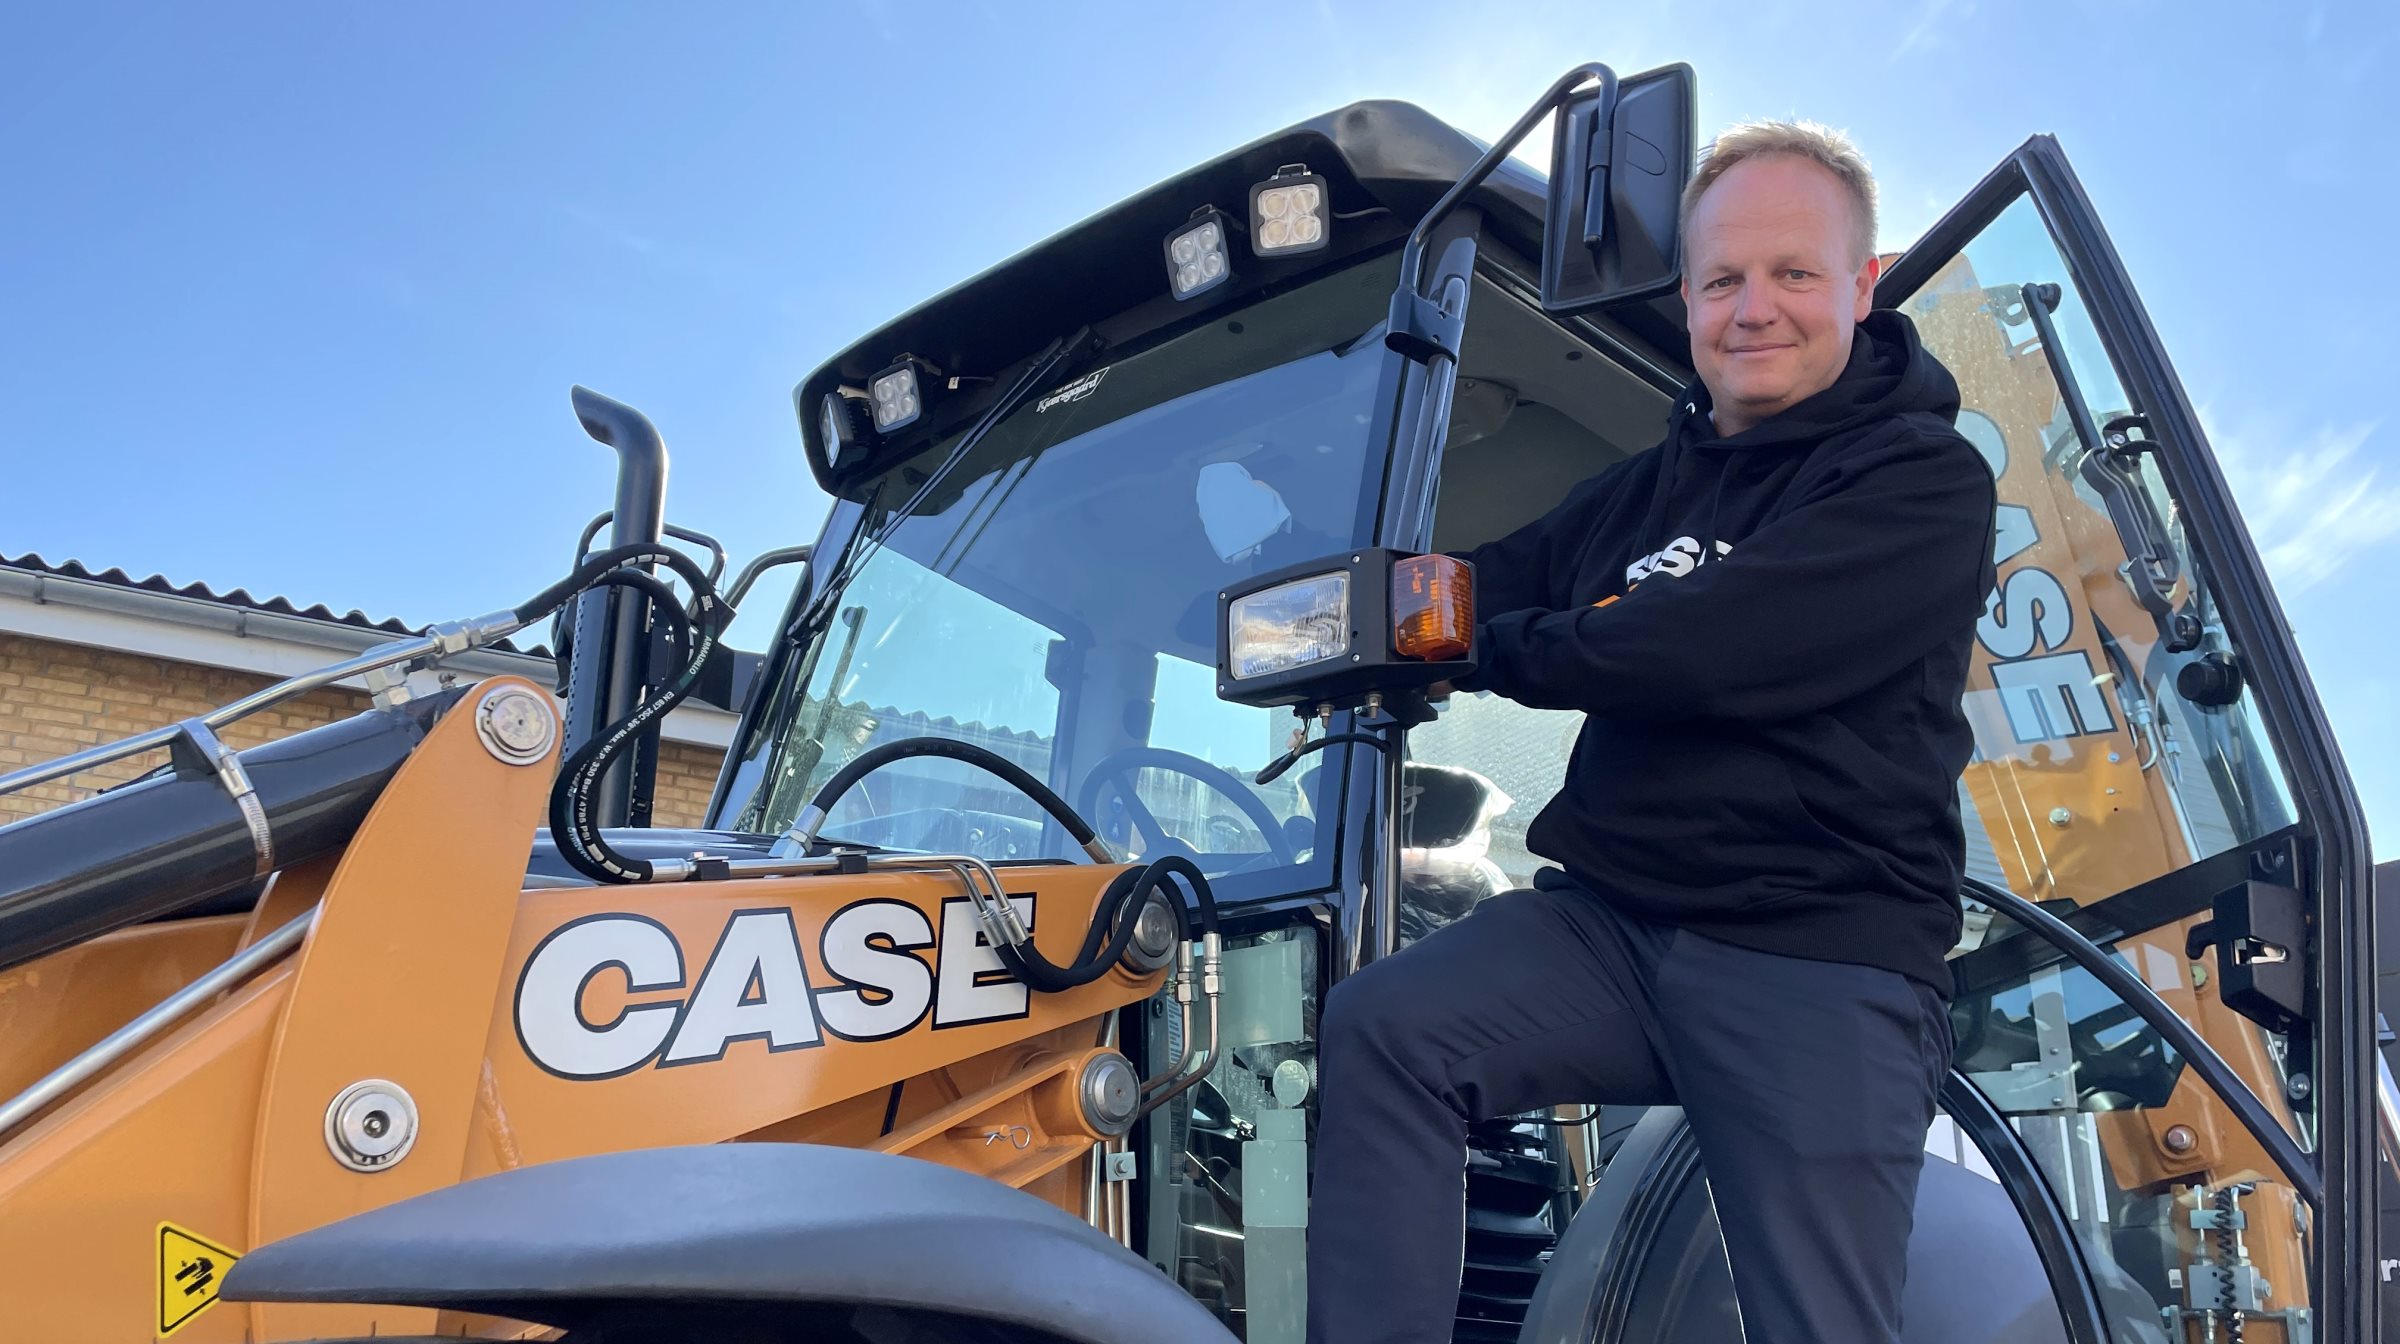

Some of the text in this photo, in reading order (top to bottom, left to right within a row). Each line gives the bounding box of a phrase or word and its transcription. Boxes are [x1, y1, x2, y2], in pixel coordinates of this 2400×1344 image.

[689, 635, 713, 675] ARMADILLO
[662, 690, 675, 702] EN
[652, 699, 665, 711] 857
[638, 707, 653, 720] 2SC
[587, 761, 600, 777] 330
[581, 777, 592, 794] Bar
[580, 825, 591, 842] PSI
[514, 892, 1036, 1081] CASE
